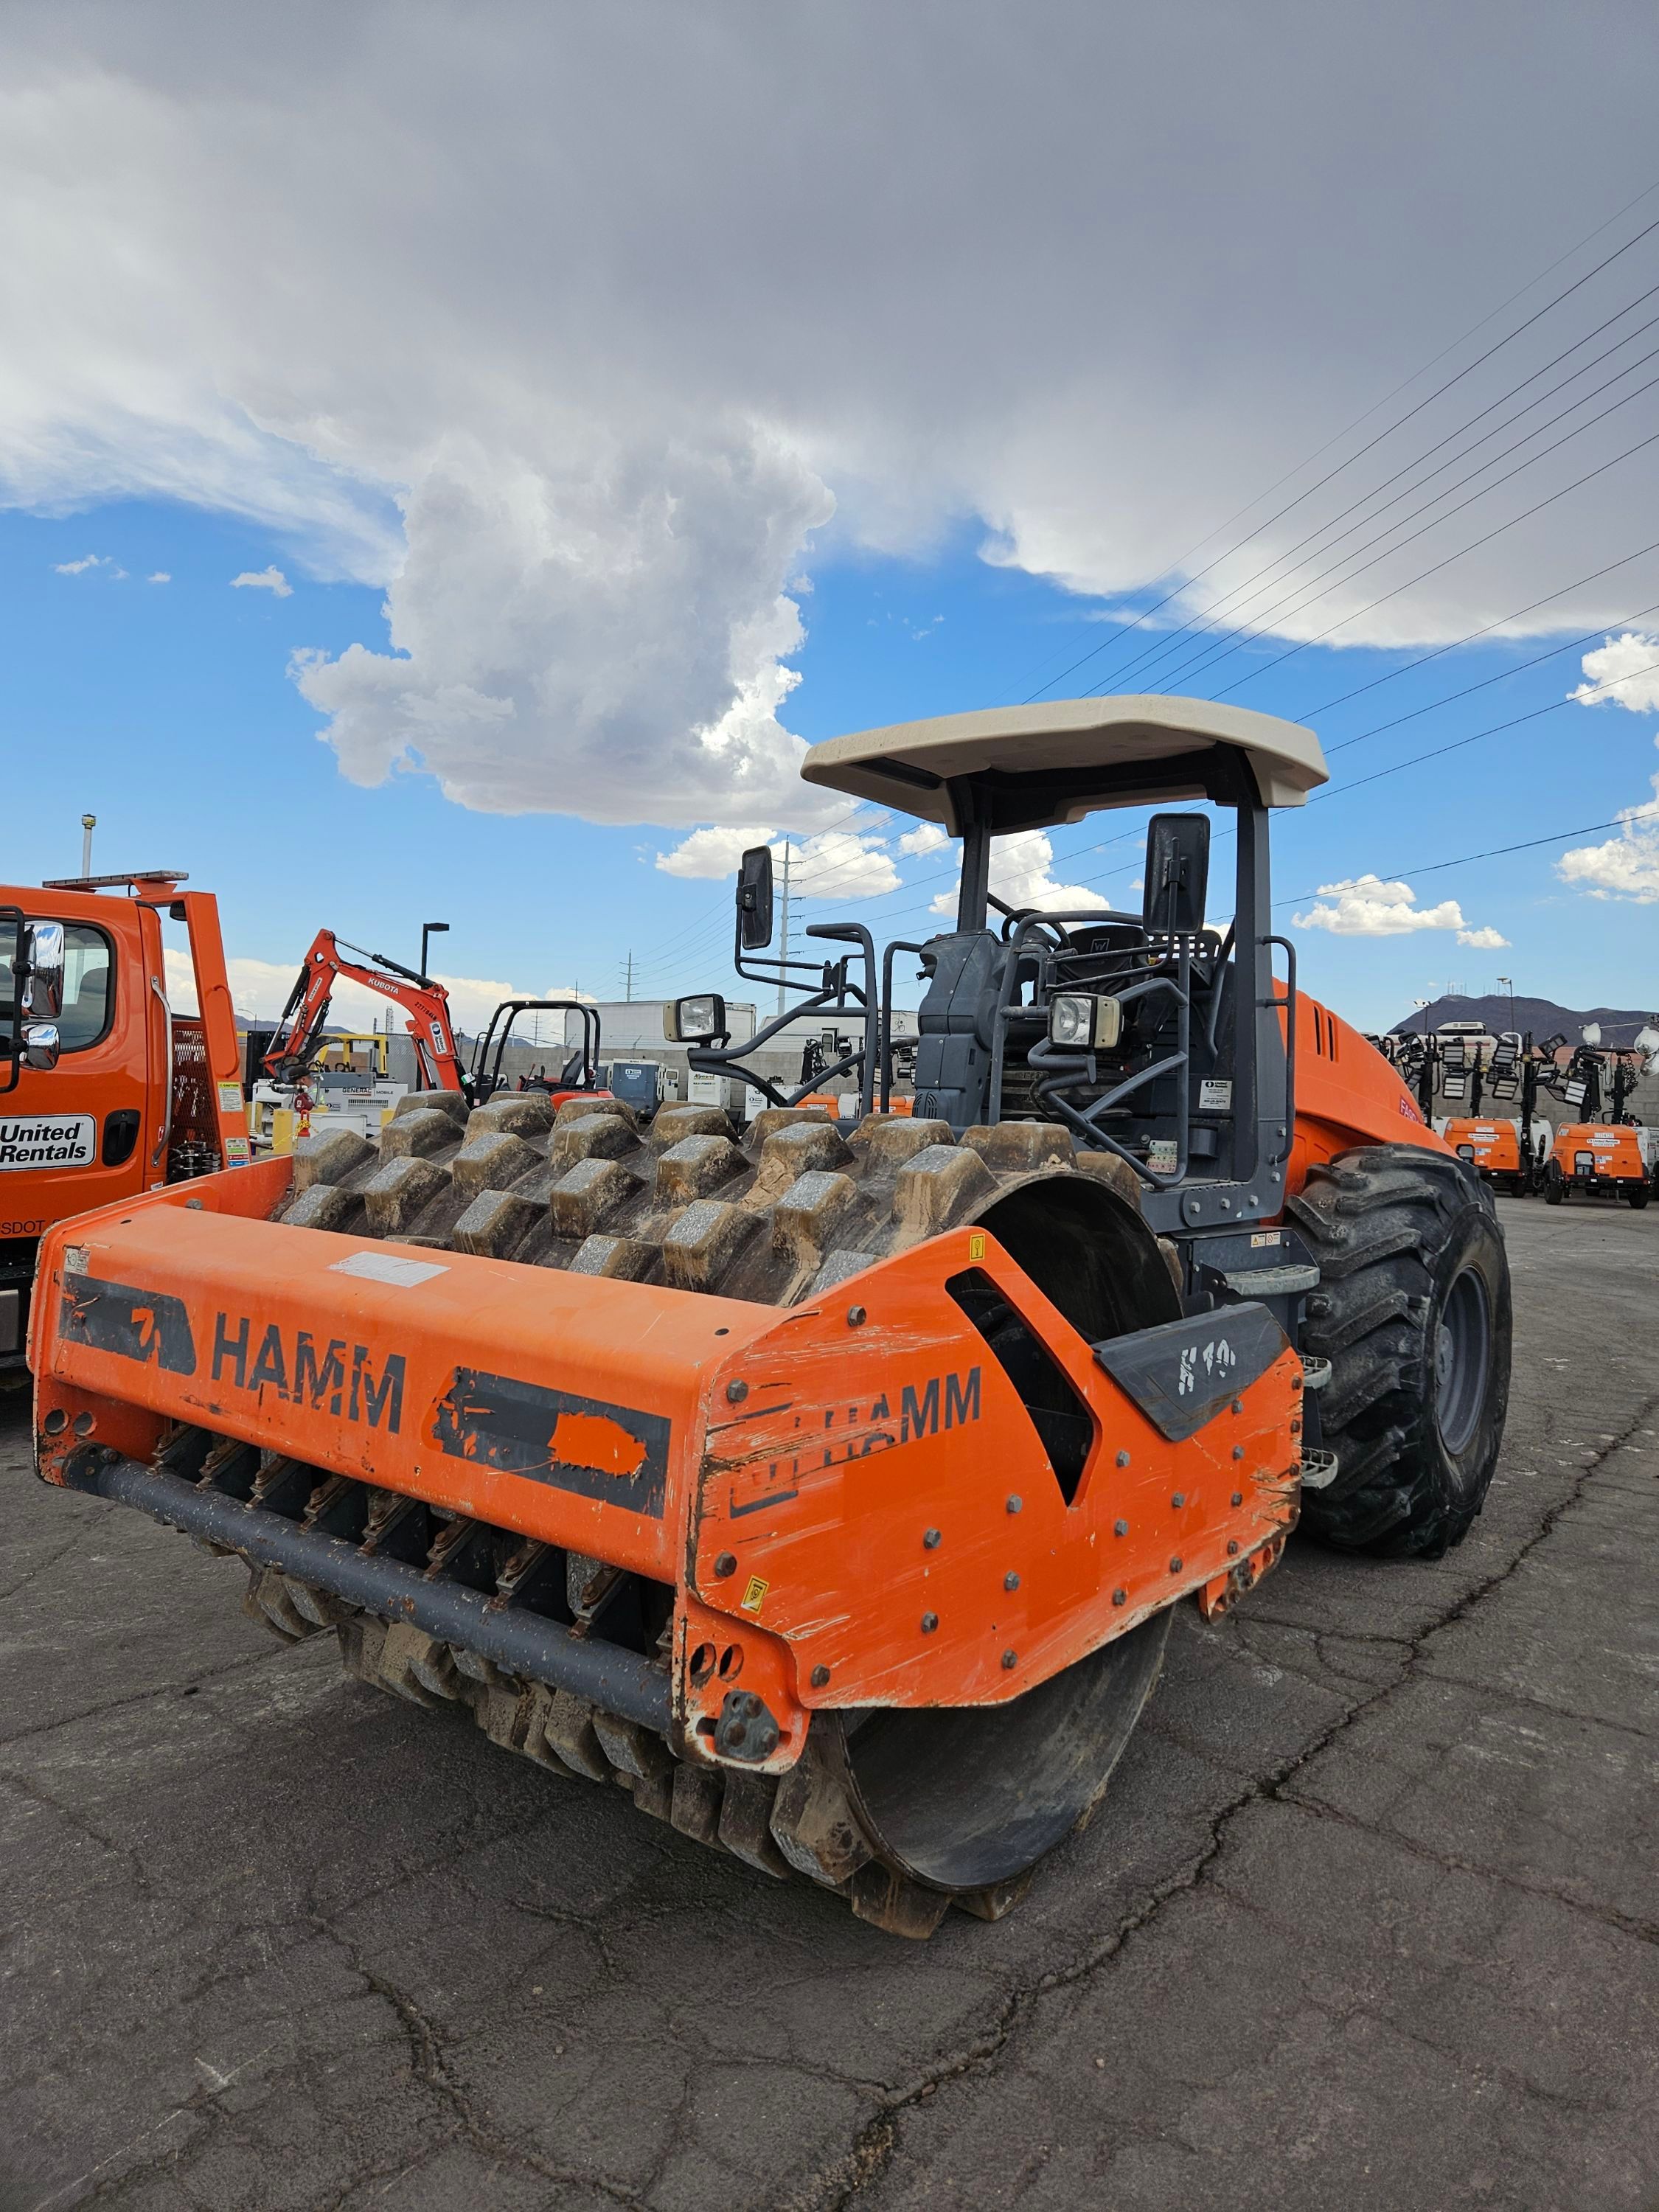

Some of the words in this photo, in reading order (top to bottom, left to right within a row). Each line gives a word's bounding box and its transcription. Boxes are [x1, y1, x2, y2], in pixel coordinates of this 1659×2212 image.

[368, 978, 399, 995] KUBOTA
[0, 1122, 81, 1143] United
[0, 1142, 87, 1163] Rentals
[211, 1311, 406, 1435] HAMM
